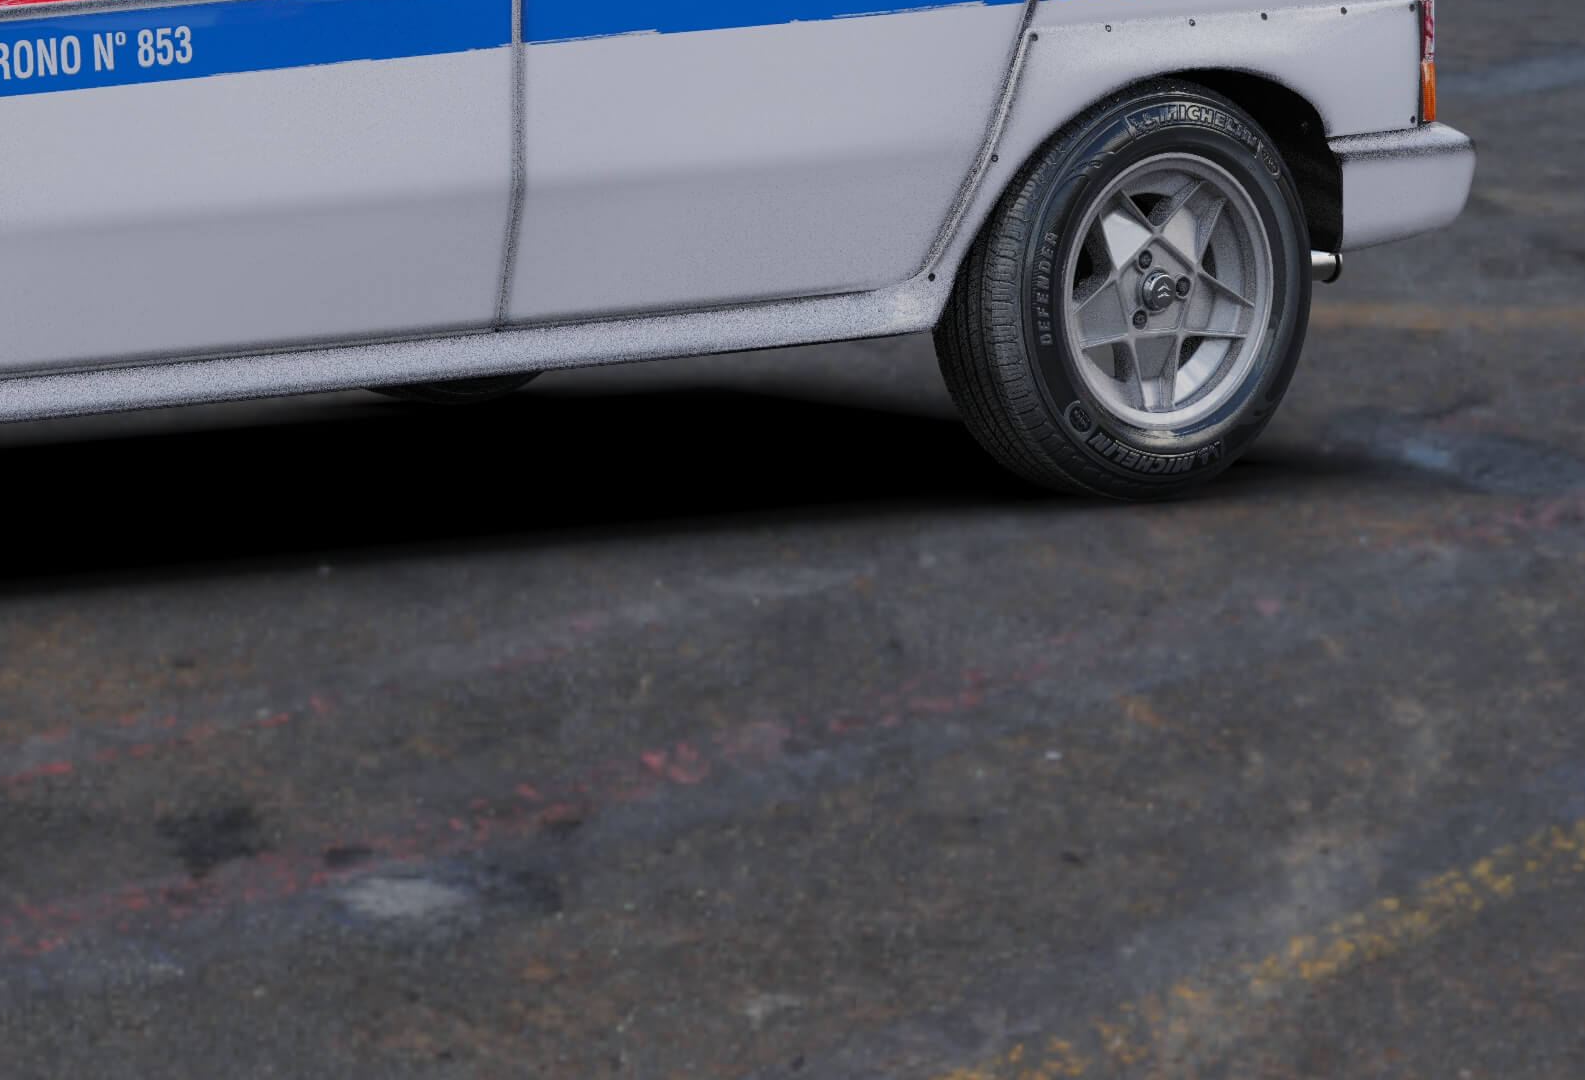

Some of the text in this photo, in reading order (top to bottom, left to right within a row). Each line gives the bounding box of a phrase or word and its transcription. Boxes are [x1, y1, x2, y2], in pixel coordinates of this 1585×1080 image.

[138, 25, 193, 68] 853
[1159, 104, 1258, 146] MICHELIN
[1037, 231, 1059, 346] DEFENDER
[1088, 431, 1196, 474] MICHELIN
